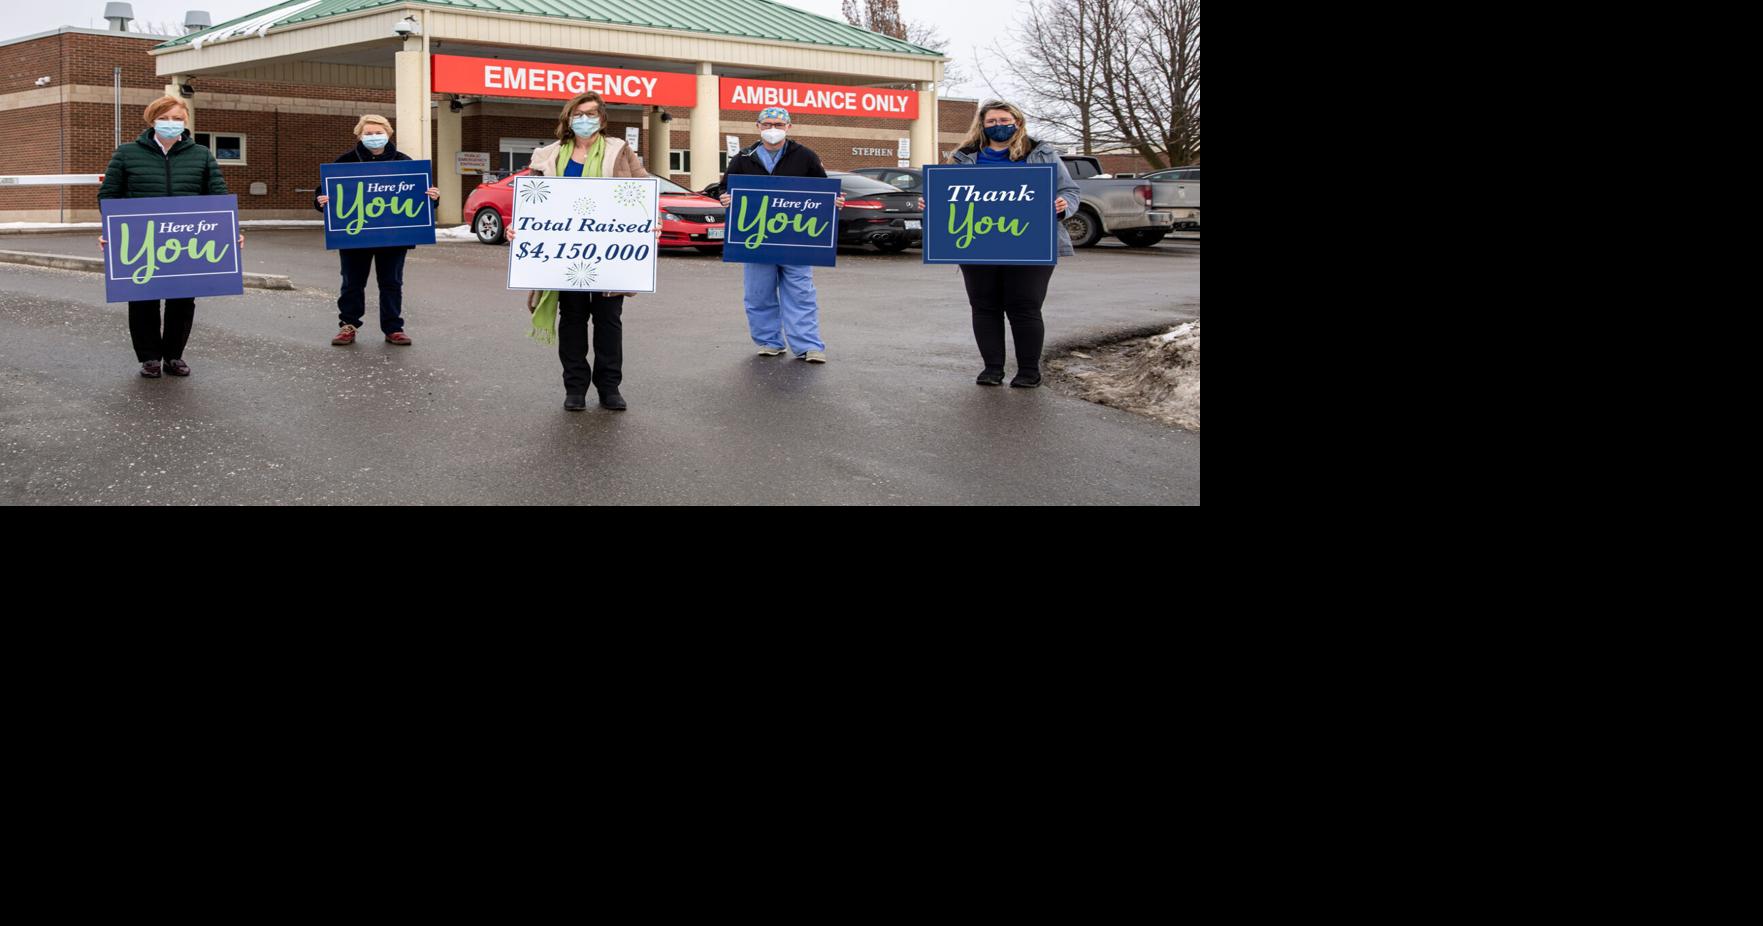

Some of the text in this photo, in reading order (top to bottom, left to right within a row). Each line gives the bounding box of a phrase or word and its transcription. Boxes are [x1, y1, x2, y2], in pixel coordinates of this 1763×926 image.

[484, 65, 658, 98] EMERGENCY
[731, 85, 909, 113] AMBULANCE ONLY
[851, 146, 894, 157] STEPHEN
[366, 181, 416, 195] Here for
[947, 184, 1036, 202] Thank
[336, 181, 425, 236] You
[770, 197, 822, 212] Here for
[158, 219, 219, 236] Here for
[518, 216, 653, 234] Total Raised
[737, 195, 830, 250] You
[948, 202, 1030, 249] You
[120, 220, 230, 285] You
[515, 241, 650, 264] $4,150,000
